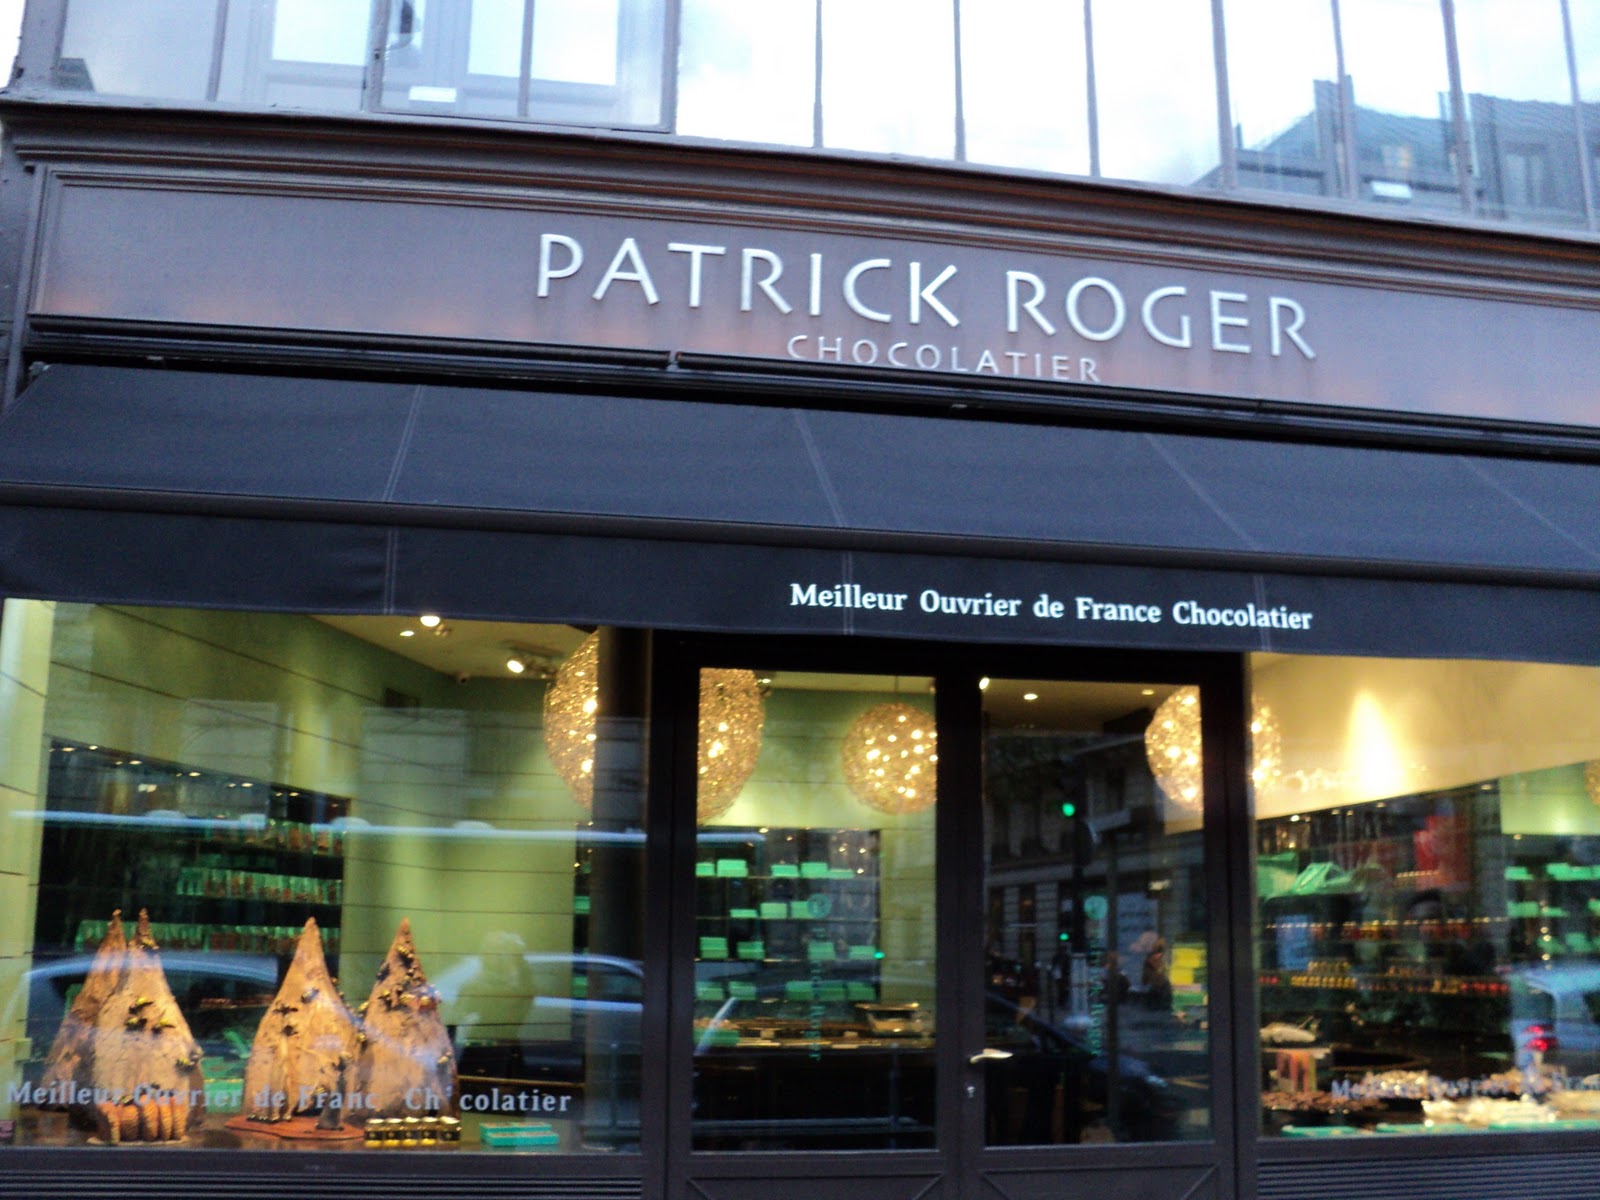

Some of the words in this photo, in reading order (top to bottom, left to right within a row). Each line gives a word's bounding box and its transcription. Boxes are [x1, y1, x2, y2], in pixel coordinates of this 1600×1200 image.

[537, 234, 960, 328] PATRICK
[1006, 271, 1316, 360] ROGER
[786, 334, 1100, 383] CHOCOLATIER
[790, 583, 908, 611] Meilleur
[919, 589, 1022, 616] Ouvrier
[1032, 594, 1065, 618] de
[1075, 597, 1162, 623] France
[1172, 601, 1313, 630] Chocolatier
[7, 1080, 126, 1106] Meilleur
[255, 1083, 287, 1108] de
[405, 1087, 572, 1112] Chcolatier
